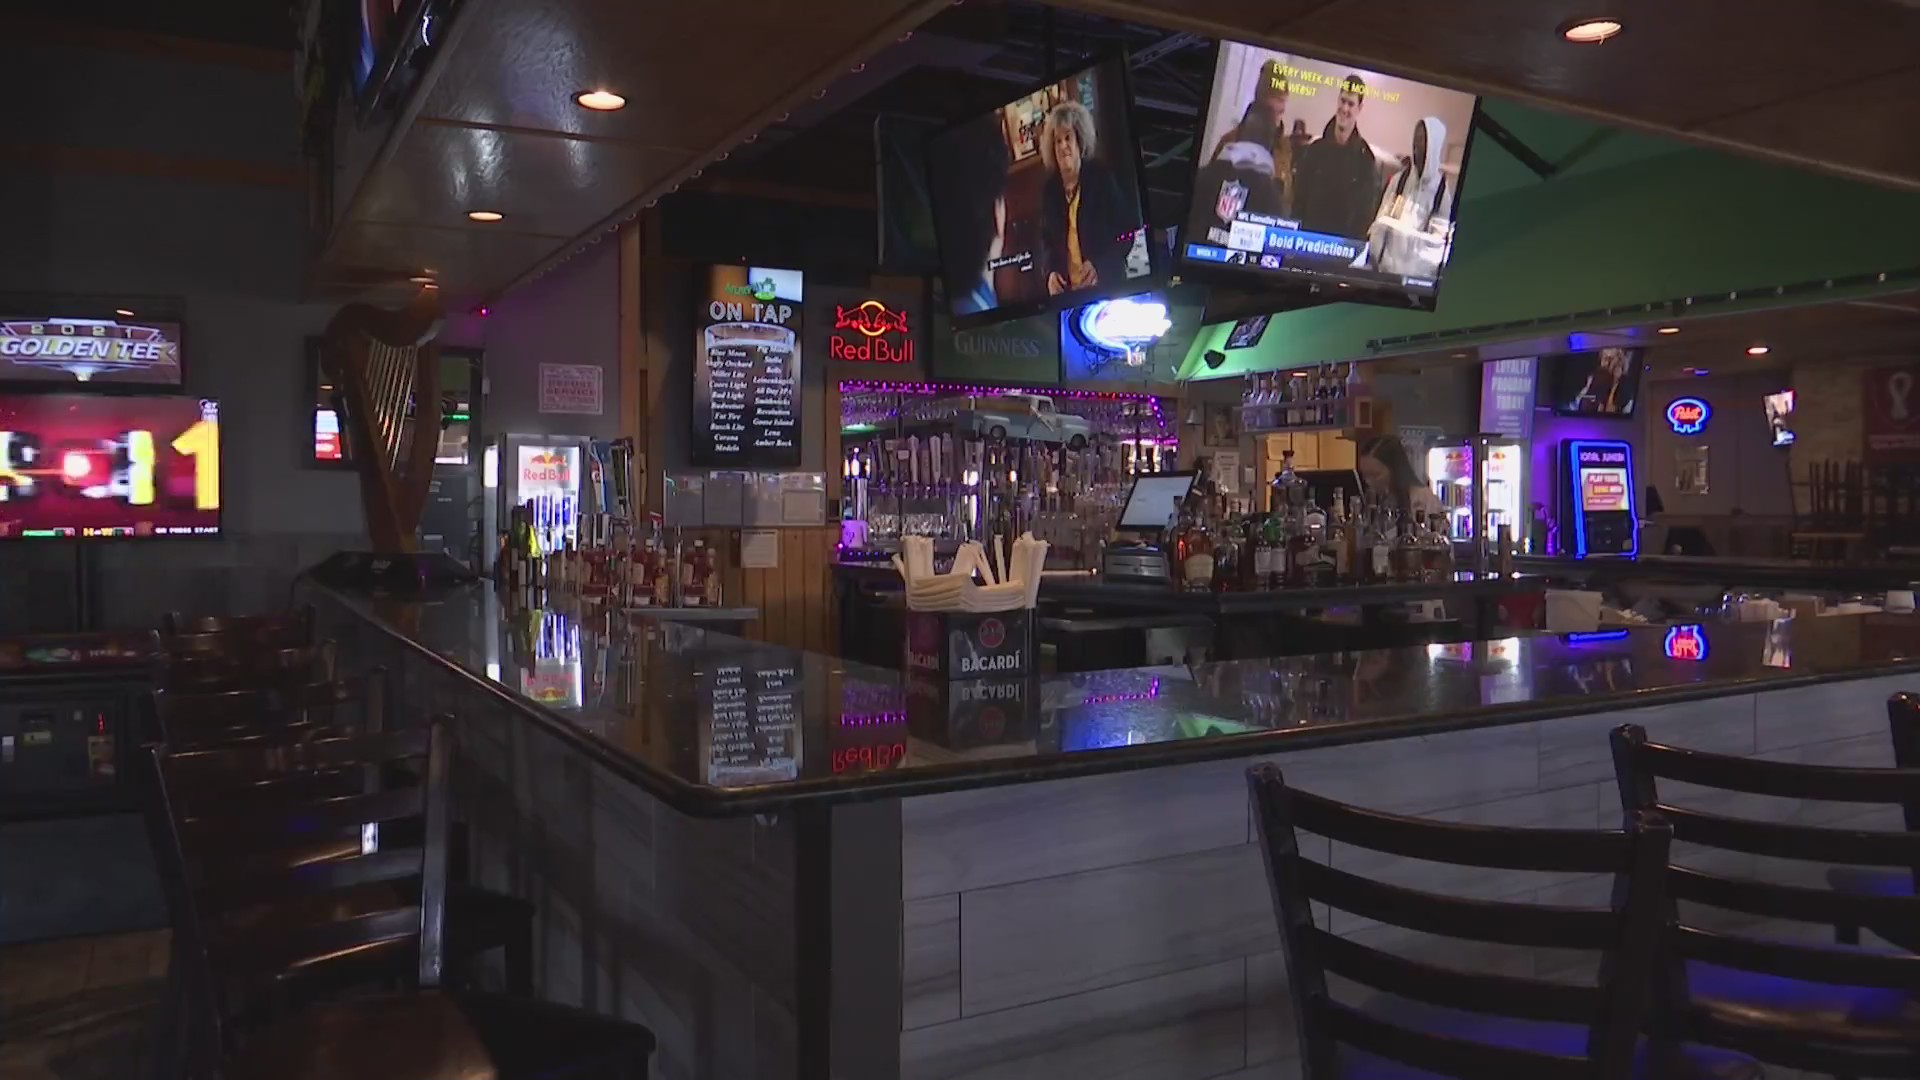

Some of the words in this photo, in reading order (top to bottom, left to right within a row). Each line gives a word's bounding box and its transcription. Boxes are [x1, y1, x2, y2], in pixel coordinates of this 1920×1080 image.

[1273, 63, 1299, 78] EVERY
[1300, 69, 1321, 83] WEEK
[1323, 76, 1334, 87] AT
[1336, 79, 1351, 91] THE
[1270, 77, 1287, 92] THE
[1269, 233, 1293, 249] Bold
[1295, 237, 1355, 259] Predictions
[710, 301, 743, 321] ON
[752, 303, 792, 324] TAP
[31, 324, 134, 339] 2021
[1, 338, 111, 358] GOLDEN
[116, 341, 162, 360] TEE
[830, 336, 872, 362] Red
[873, 336, 915, 363] Bull
[954, 331, 1040, 358] GUINNESS
[729, 349, 747, 358] Moon
[725, 360, 753, 369] Orchard
[764, 355, 783, 364] Stella
[712, 370, 731, 378] Miller
[709, 380, 729, 389] Coors
[730, 380, 748, 390] Light
[1491, 376, 1532, 392] PROGRAM
[545, 387, 594, 396] SERVICE
[712, 391, 727, 399] Bud
[727, 391, 745, 401] Light
[766, 387, 779, 397] Day
[711, 401, 745, 410] Budweiser
[714, 412, 727, 420] Fat
[728, 412, 741, 421] Tire
[756, 408, 790, 416] Revolution
[710, 422, 731, 431] Busch
[731, 423, 746, 432] Lite
[752, 418, 772, 426] Goose
[773, 418, 795, 427] Island
[714, 433, 739, 442] Corona
[764, 428, 781, 437] Lena
[715, 443, 740, 452] Modelo
[754, 439, 776, 447] Amber
[776, 439, 792, 447] Bock
[523, 468, 547, 480] Red
[194, 525, 219, 535] START
[961, 649, 1022, 672] BACARDÍ
